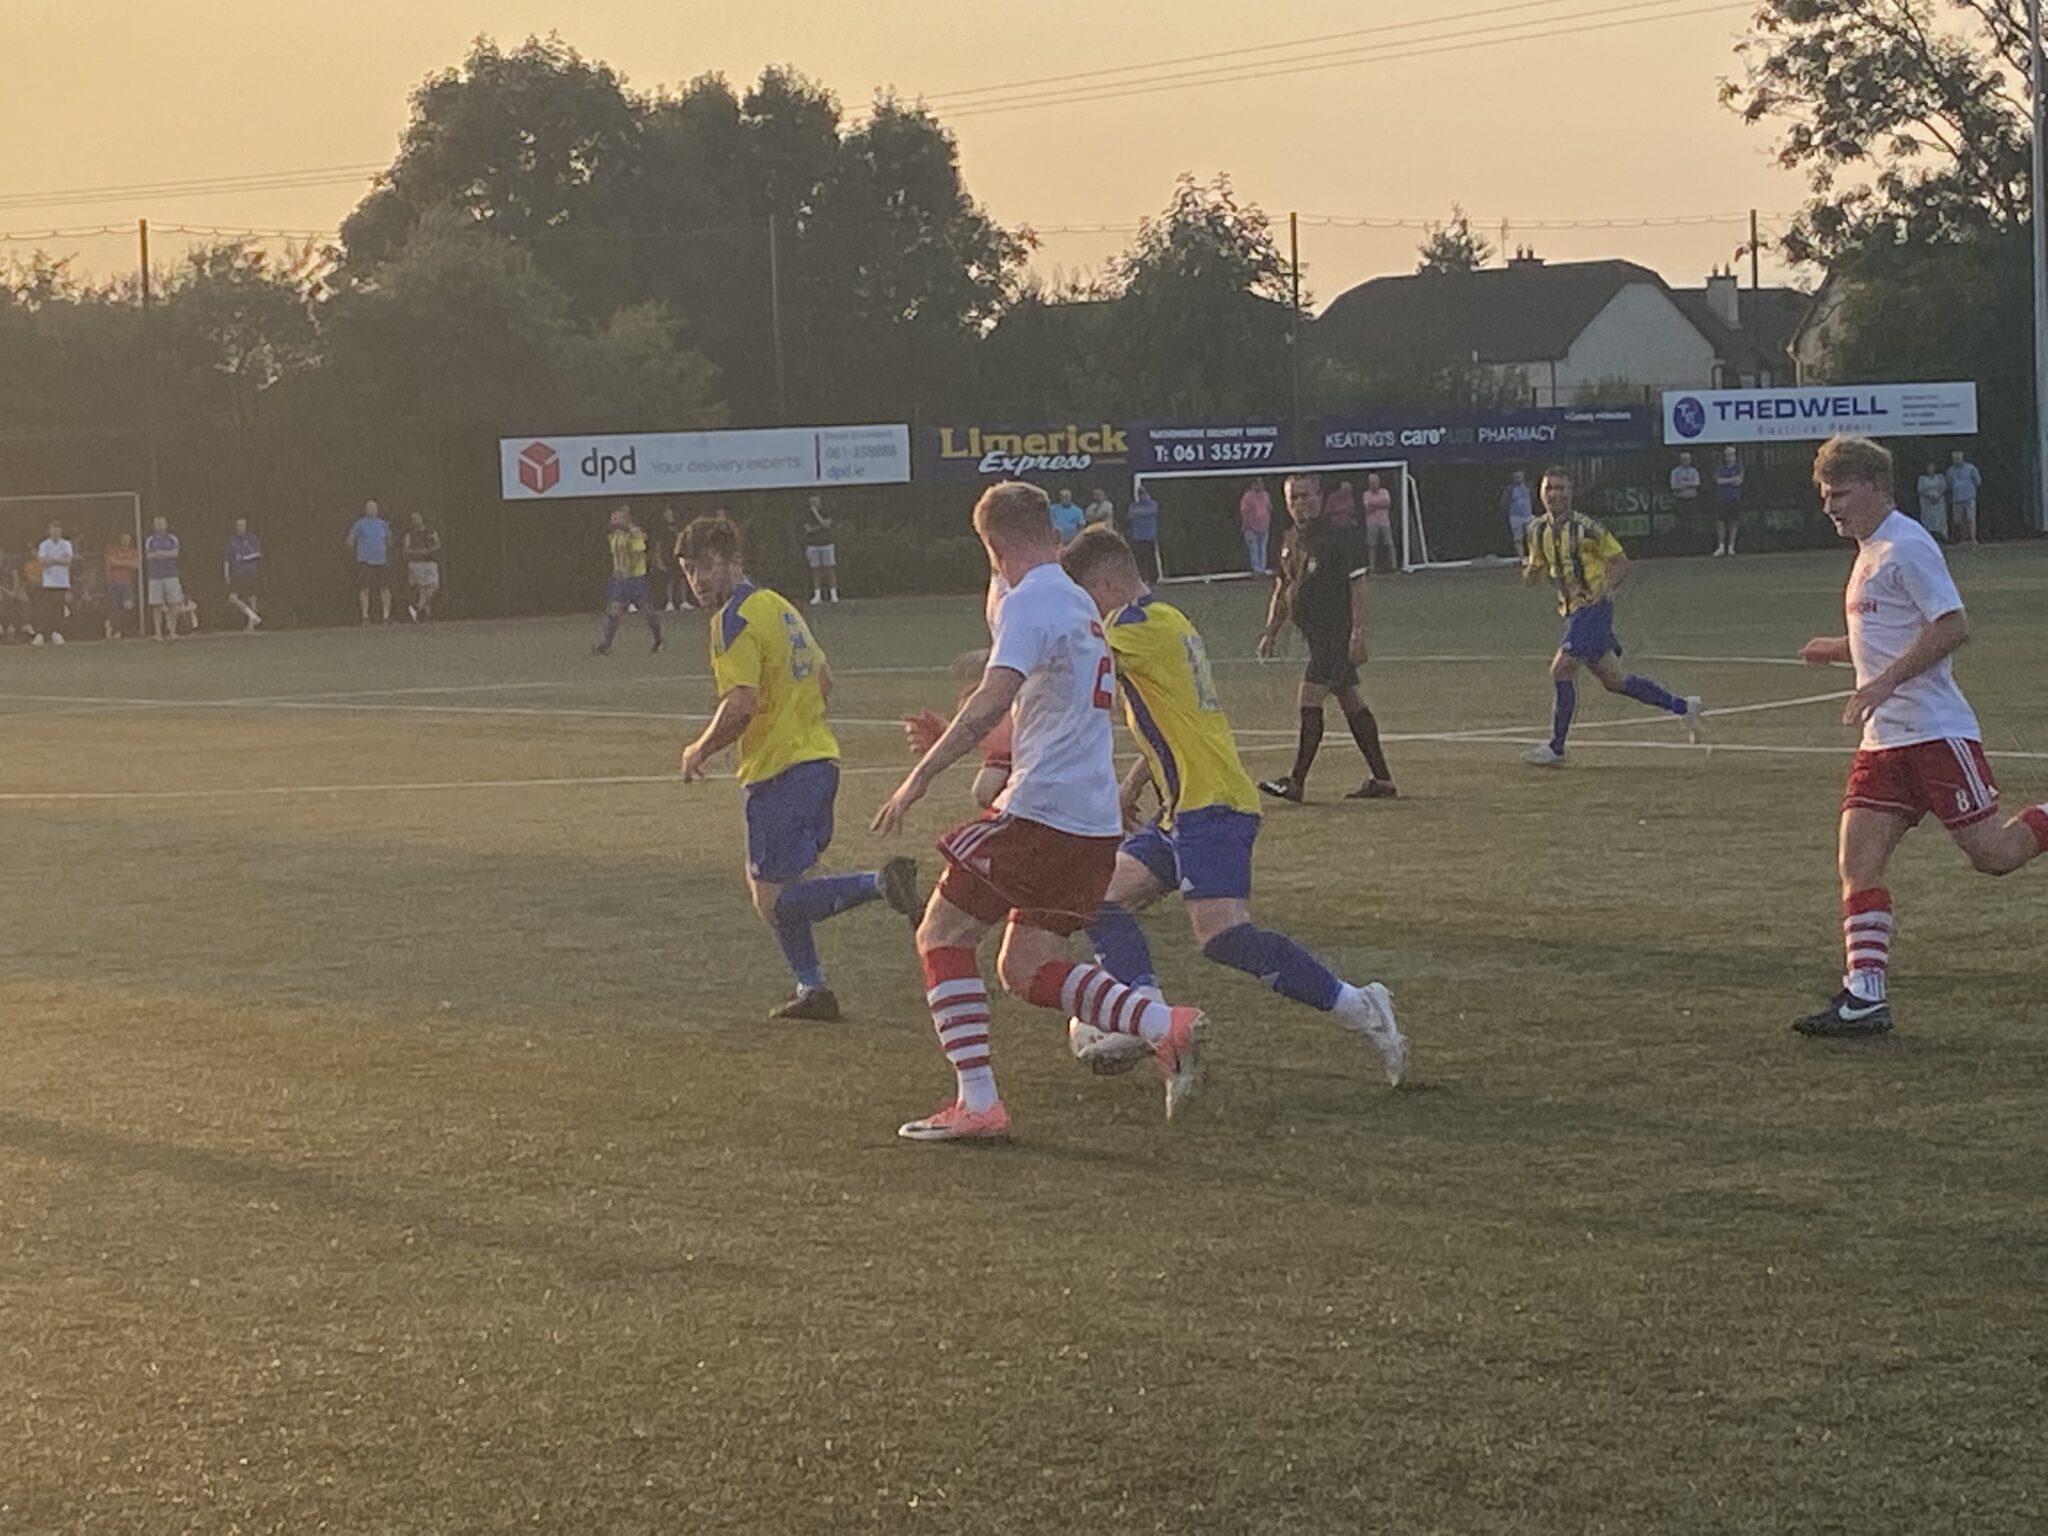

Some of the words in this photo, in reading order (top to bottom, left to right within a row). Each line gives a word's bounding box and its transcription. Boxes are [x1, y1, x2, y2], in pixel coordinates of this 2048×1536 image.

[1712, 396, 1889, 421] TREDWELL
[940, 423, 1129, 458] Limerick
[1325, 430, 1396, 448] KEATING'S
[1478, 425, 1557, 444] PHARMACY
[978, 450, 1093, 476] Express
[1154, 444, 1169, 462] T:
[1173, 443, 1205, 461] 061
[1211, 441, 1274, 460] 355777
[581, 446, 637, 483] dpd
[650, 461, 684, 474] Your
[687, 457, 744, 474] delivery
[747, 455, 802, 472] experts
[1955, 790, 1970, 811] 8
